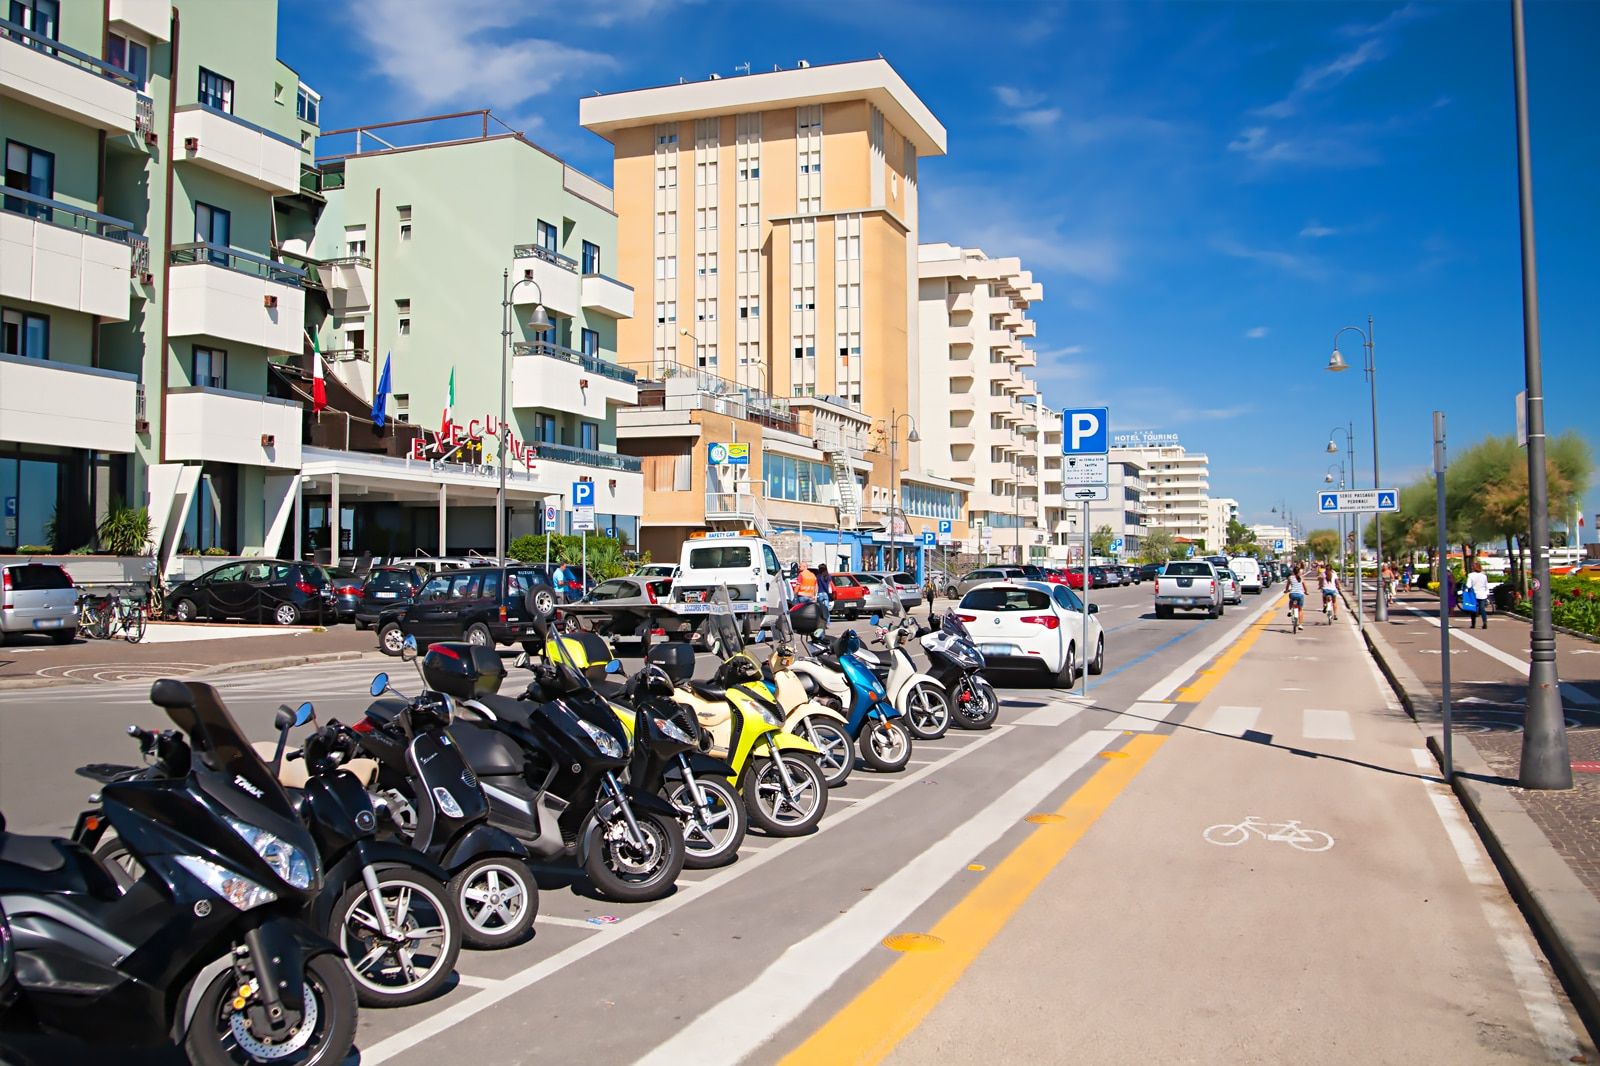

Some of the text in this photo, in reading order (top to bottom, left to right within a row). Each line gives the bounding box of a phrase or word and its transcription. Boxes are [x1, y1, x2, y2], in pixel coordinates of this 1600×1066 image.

[1072, 413, 1099, 449] P
[1143, 433, 1179, 441] TOURING
[576, 484, 591, 504] P
[941, 522, 949, 532] P
[925, 533, 934, 545] P
